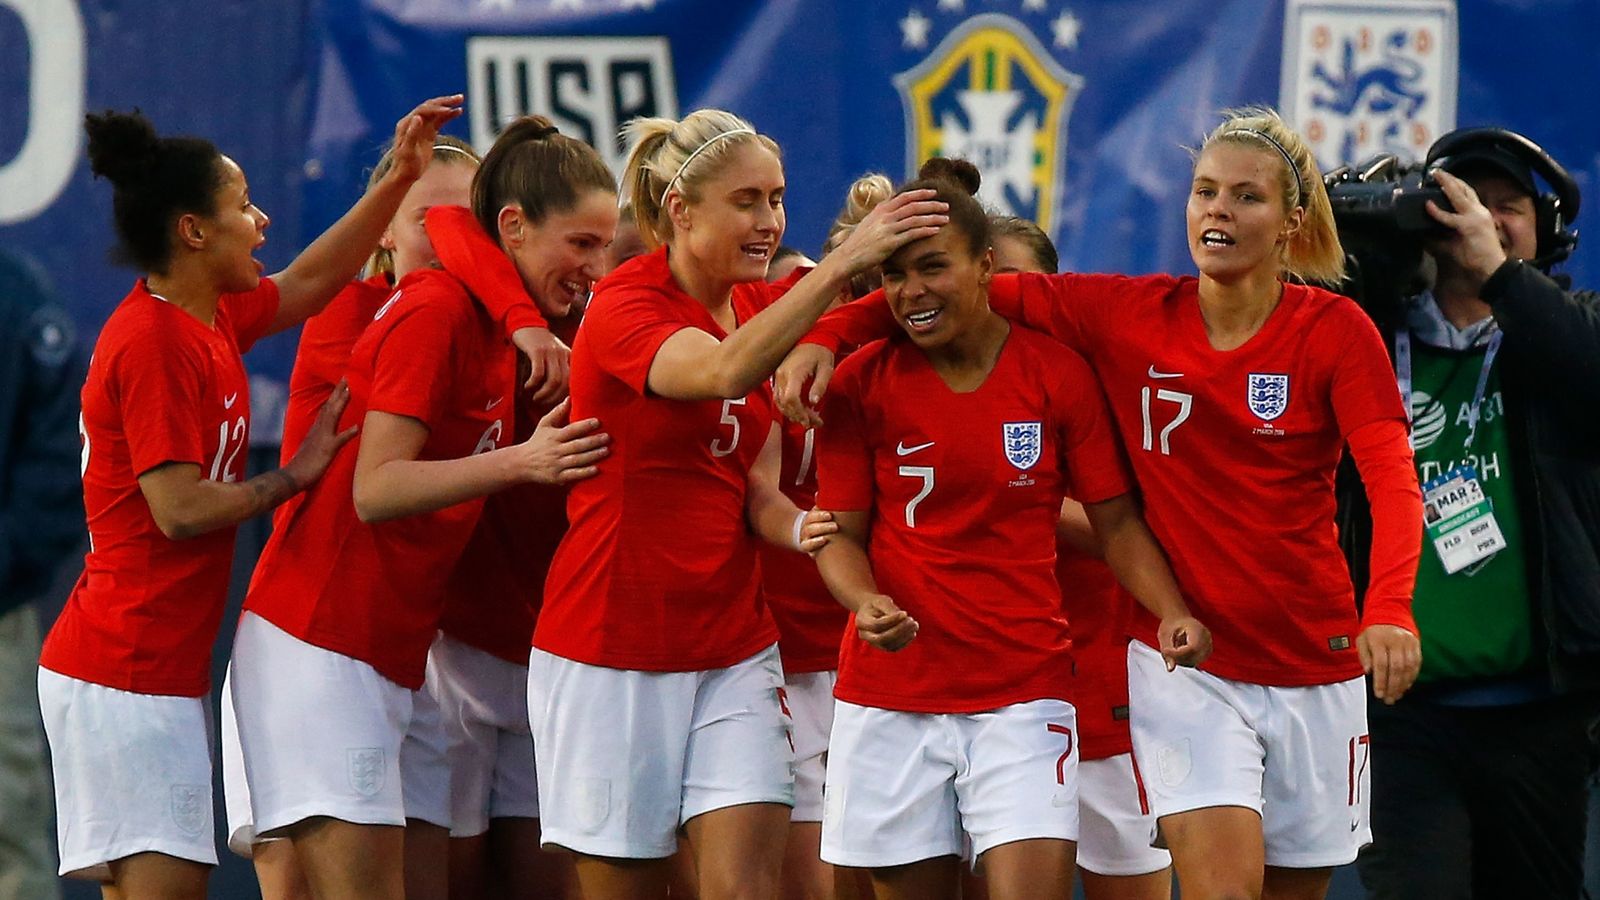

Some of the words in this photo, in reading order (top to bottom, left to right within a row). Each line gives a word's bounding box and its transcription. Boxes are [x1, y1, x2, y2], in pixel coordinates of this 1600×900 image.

[485, 58, 656, 154] USA
[209, 415, 246, 483] 12
[472, 419, 502, 455] 6
[710, 397, 746, 457] 5
[1141, 386, 1193, 455] 17
[898, 466, 935, 528] 7
[1437, 487, 1467, 508] MAR
[1469, 481, 1478, 493] 2
[1047, 722, 1073, 785] 7
[1347, 735, 1370, 806] 17
